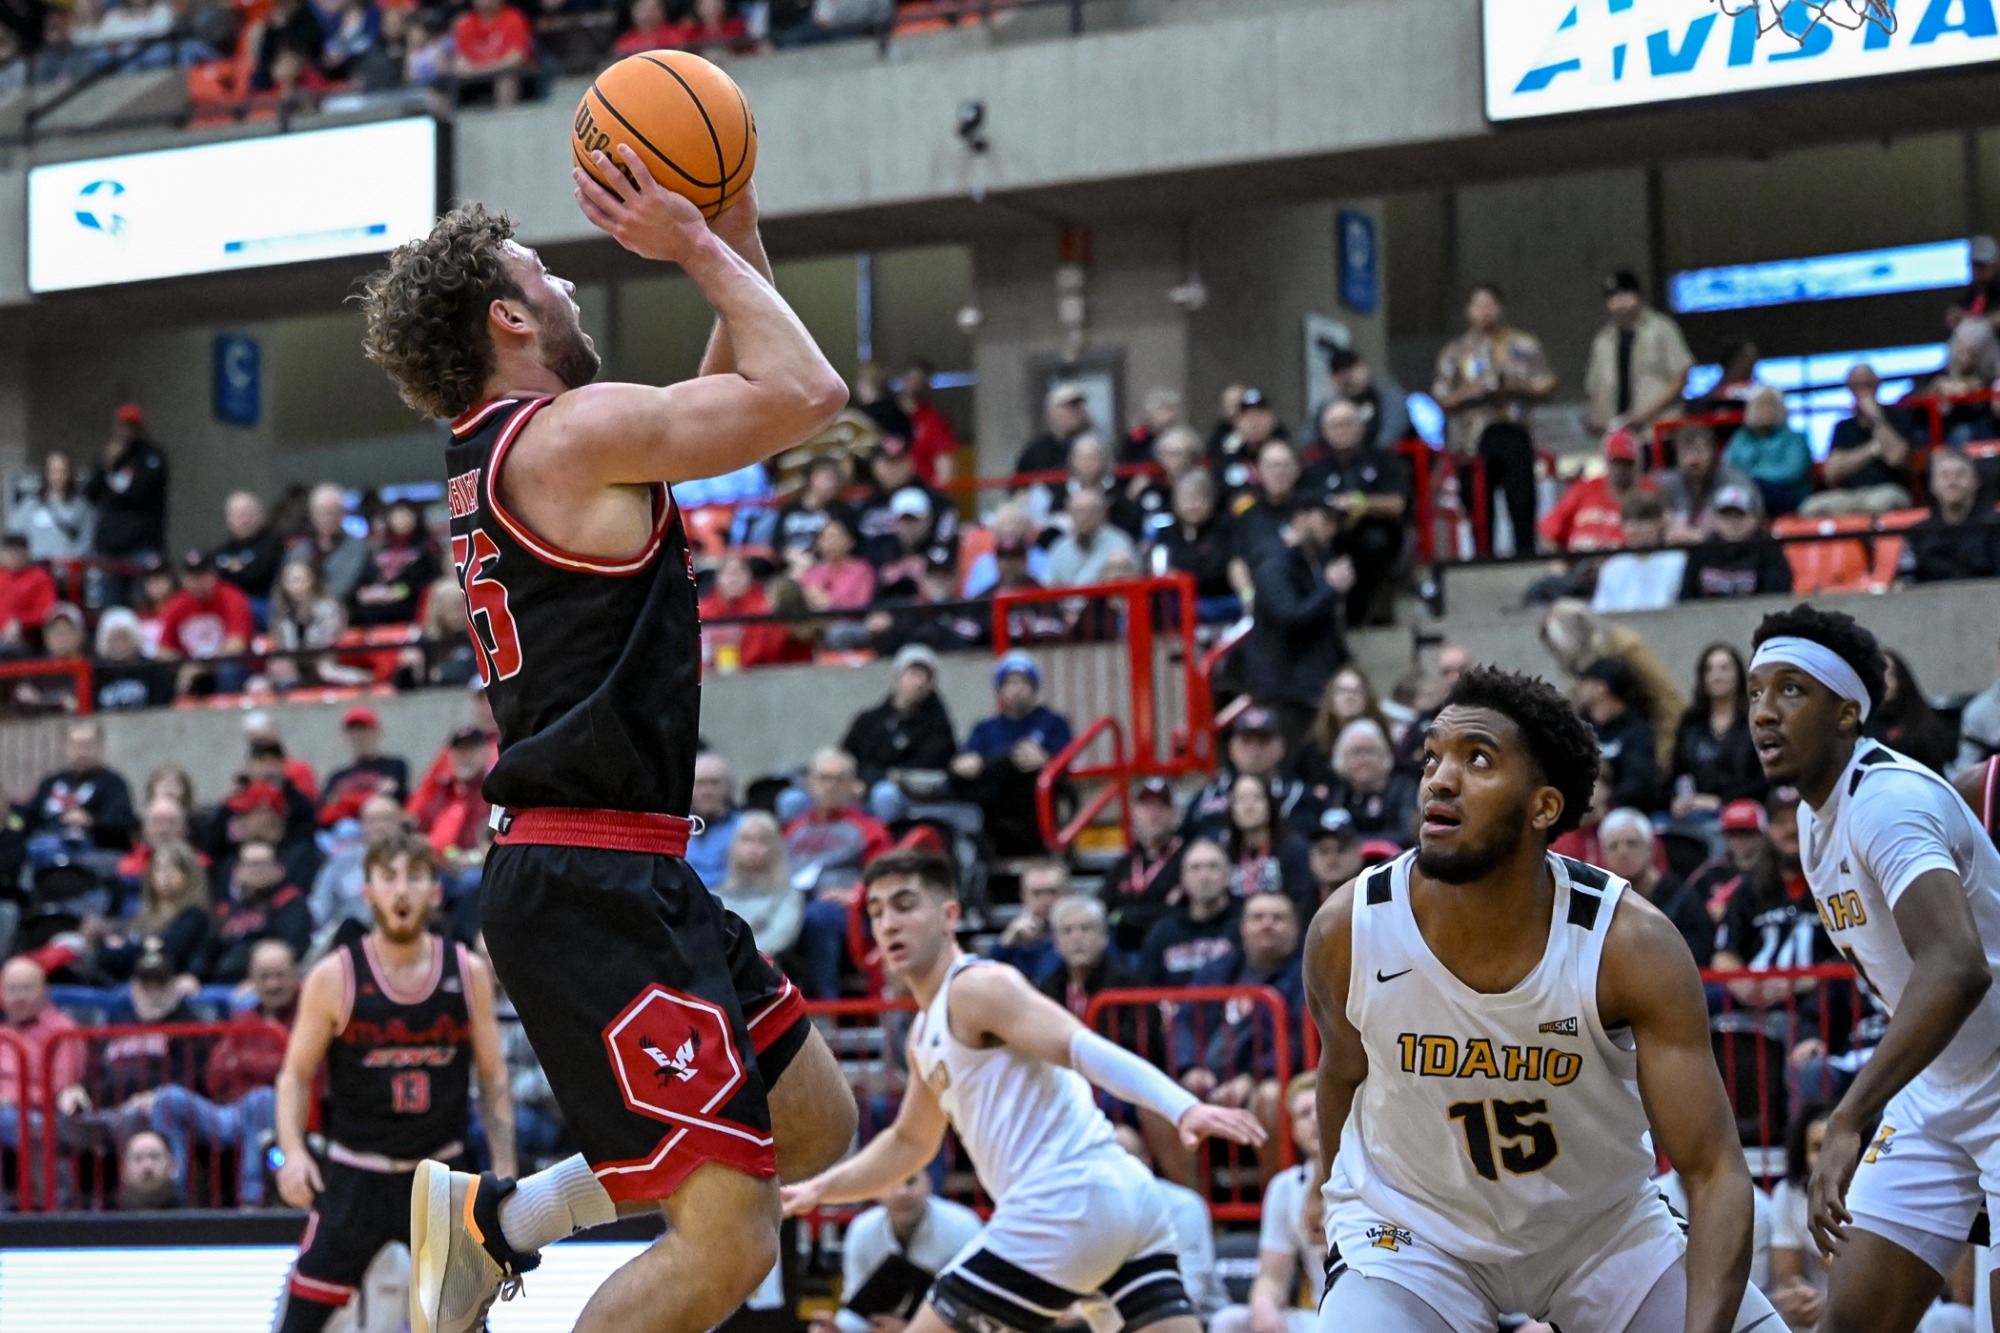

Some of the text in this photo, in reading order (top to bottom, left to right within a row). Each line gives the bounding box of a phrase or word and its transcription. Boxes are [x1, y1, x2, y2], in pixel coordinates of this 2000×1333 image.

[1397, 1033, 1583, 1087] IDAHO
[391, 1071, 431, 1114] 13
[1446, 1098, 1560, 1183] 15
